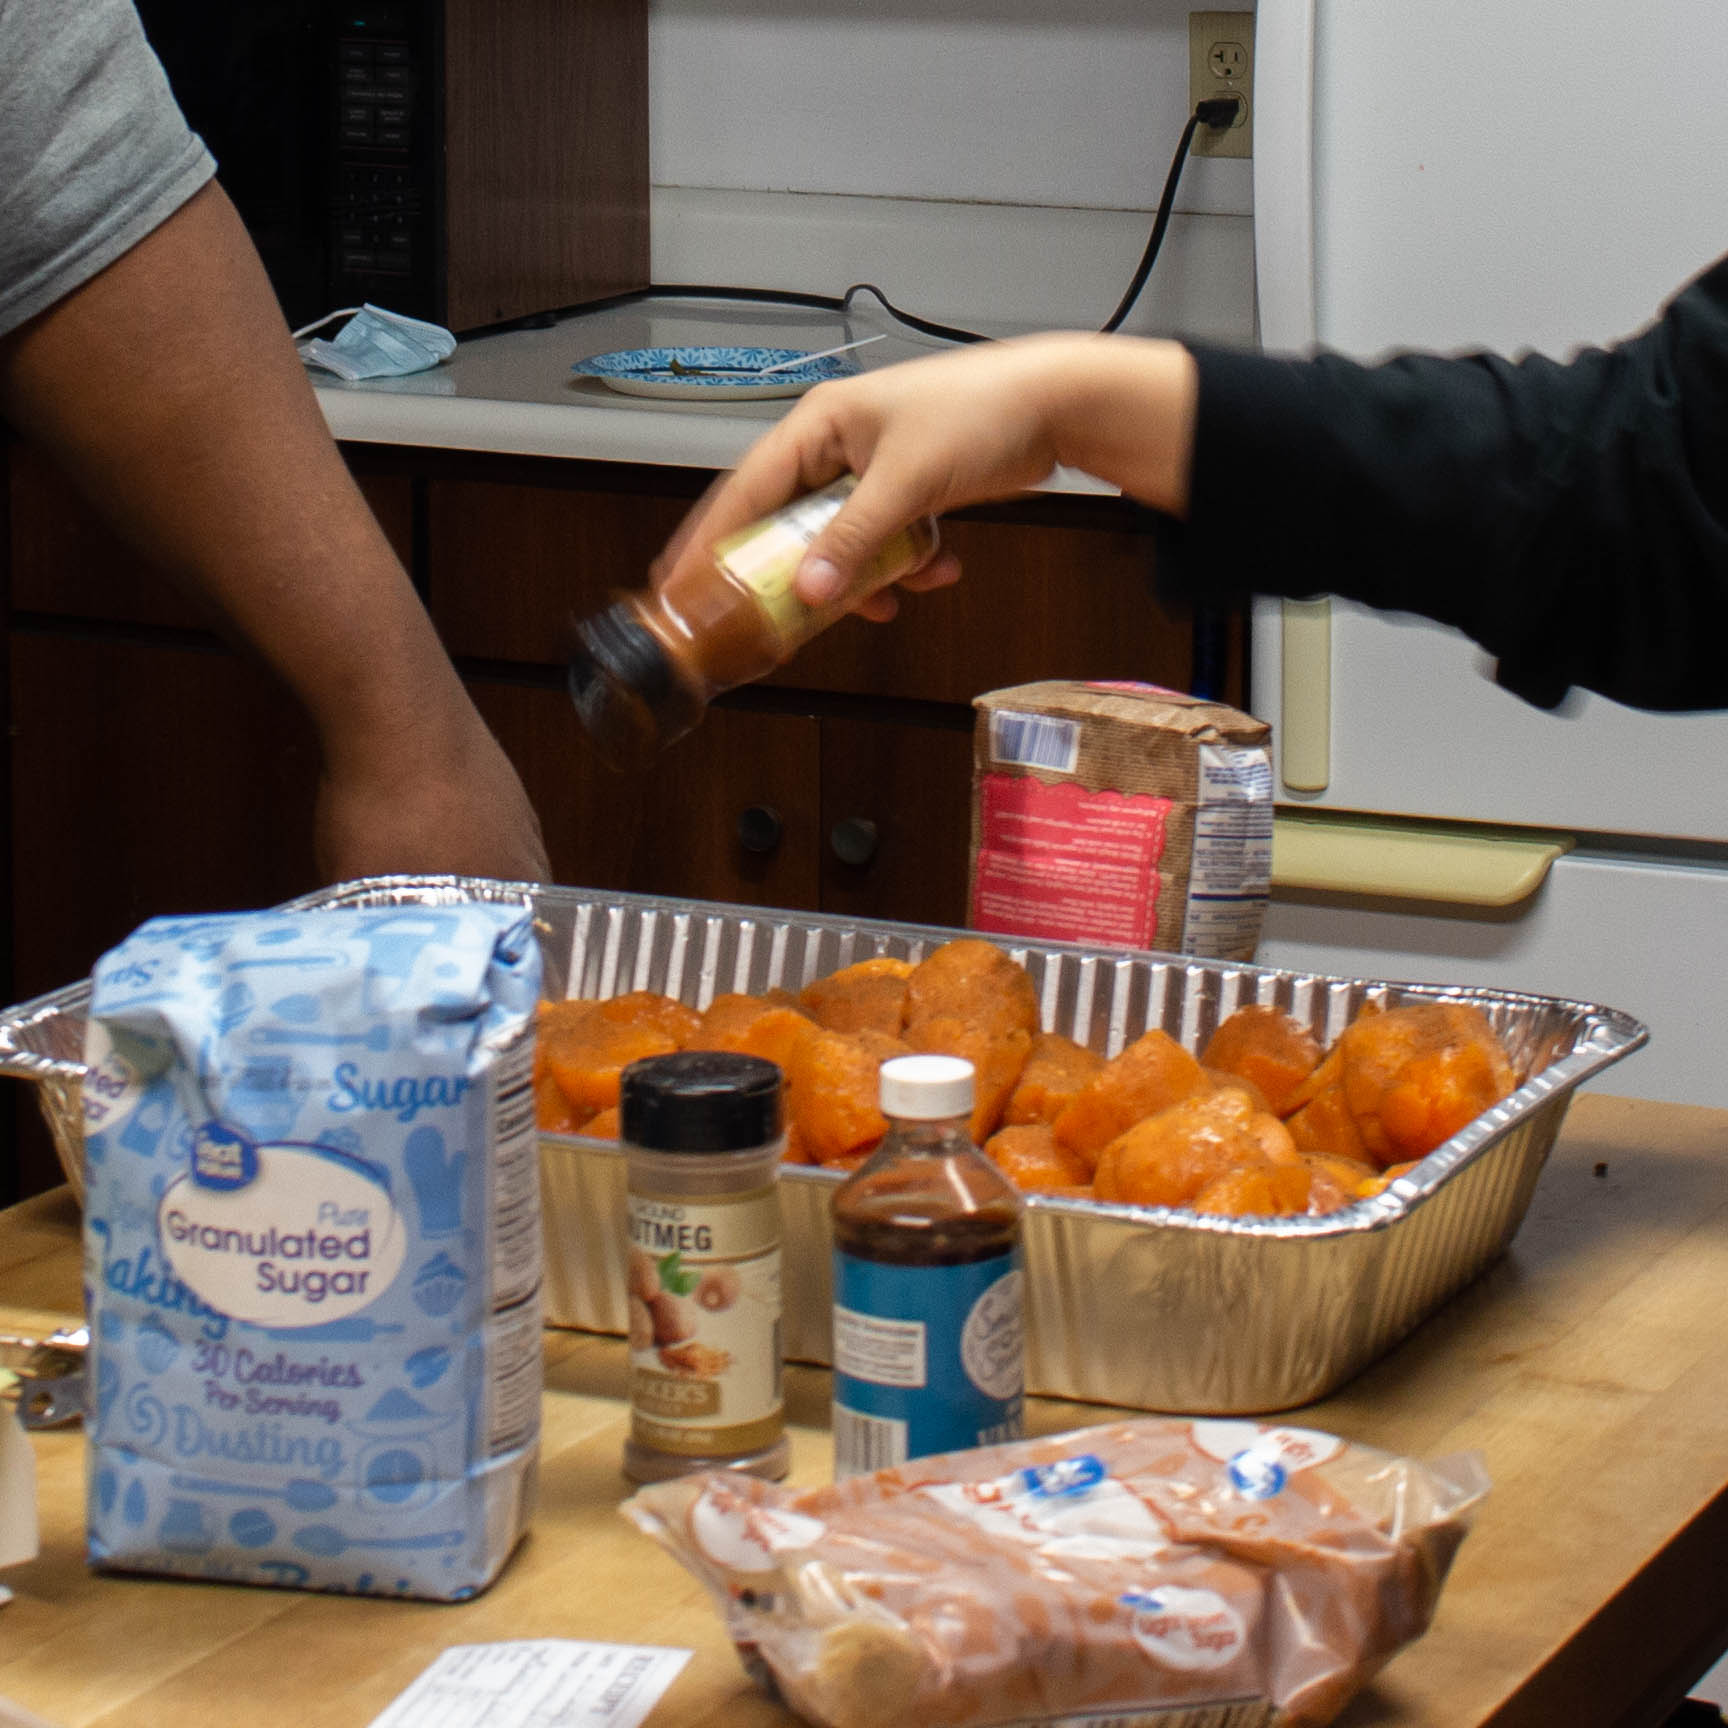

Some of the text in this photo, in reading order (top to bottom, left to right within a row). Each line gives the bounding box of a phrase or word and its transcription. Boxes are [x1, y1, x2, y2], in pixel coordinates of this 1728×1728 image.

[325, 1060, 472, 1123] Sugar
[166, 1209, 371, 1261] Granulated
[255, 1259, 370, 1304] Sugar
[233, 1346, 366, 1390] Calories
[244, 1386, 343, 1426] Serving
[172, 1403, 349, 1479] Dusting
